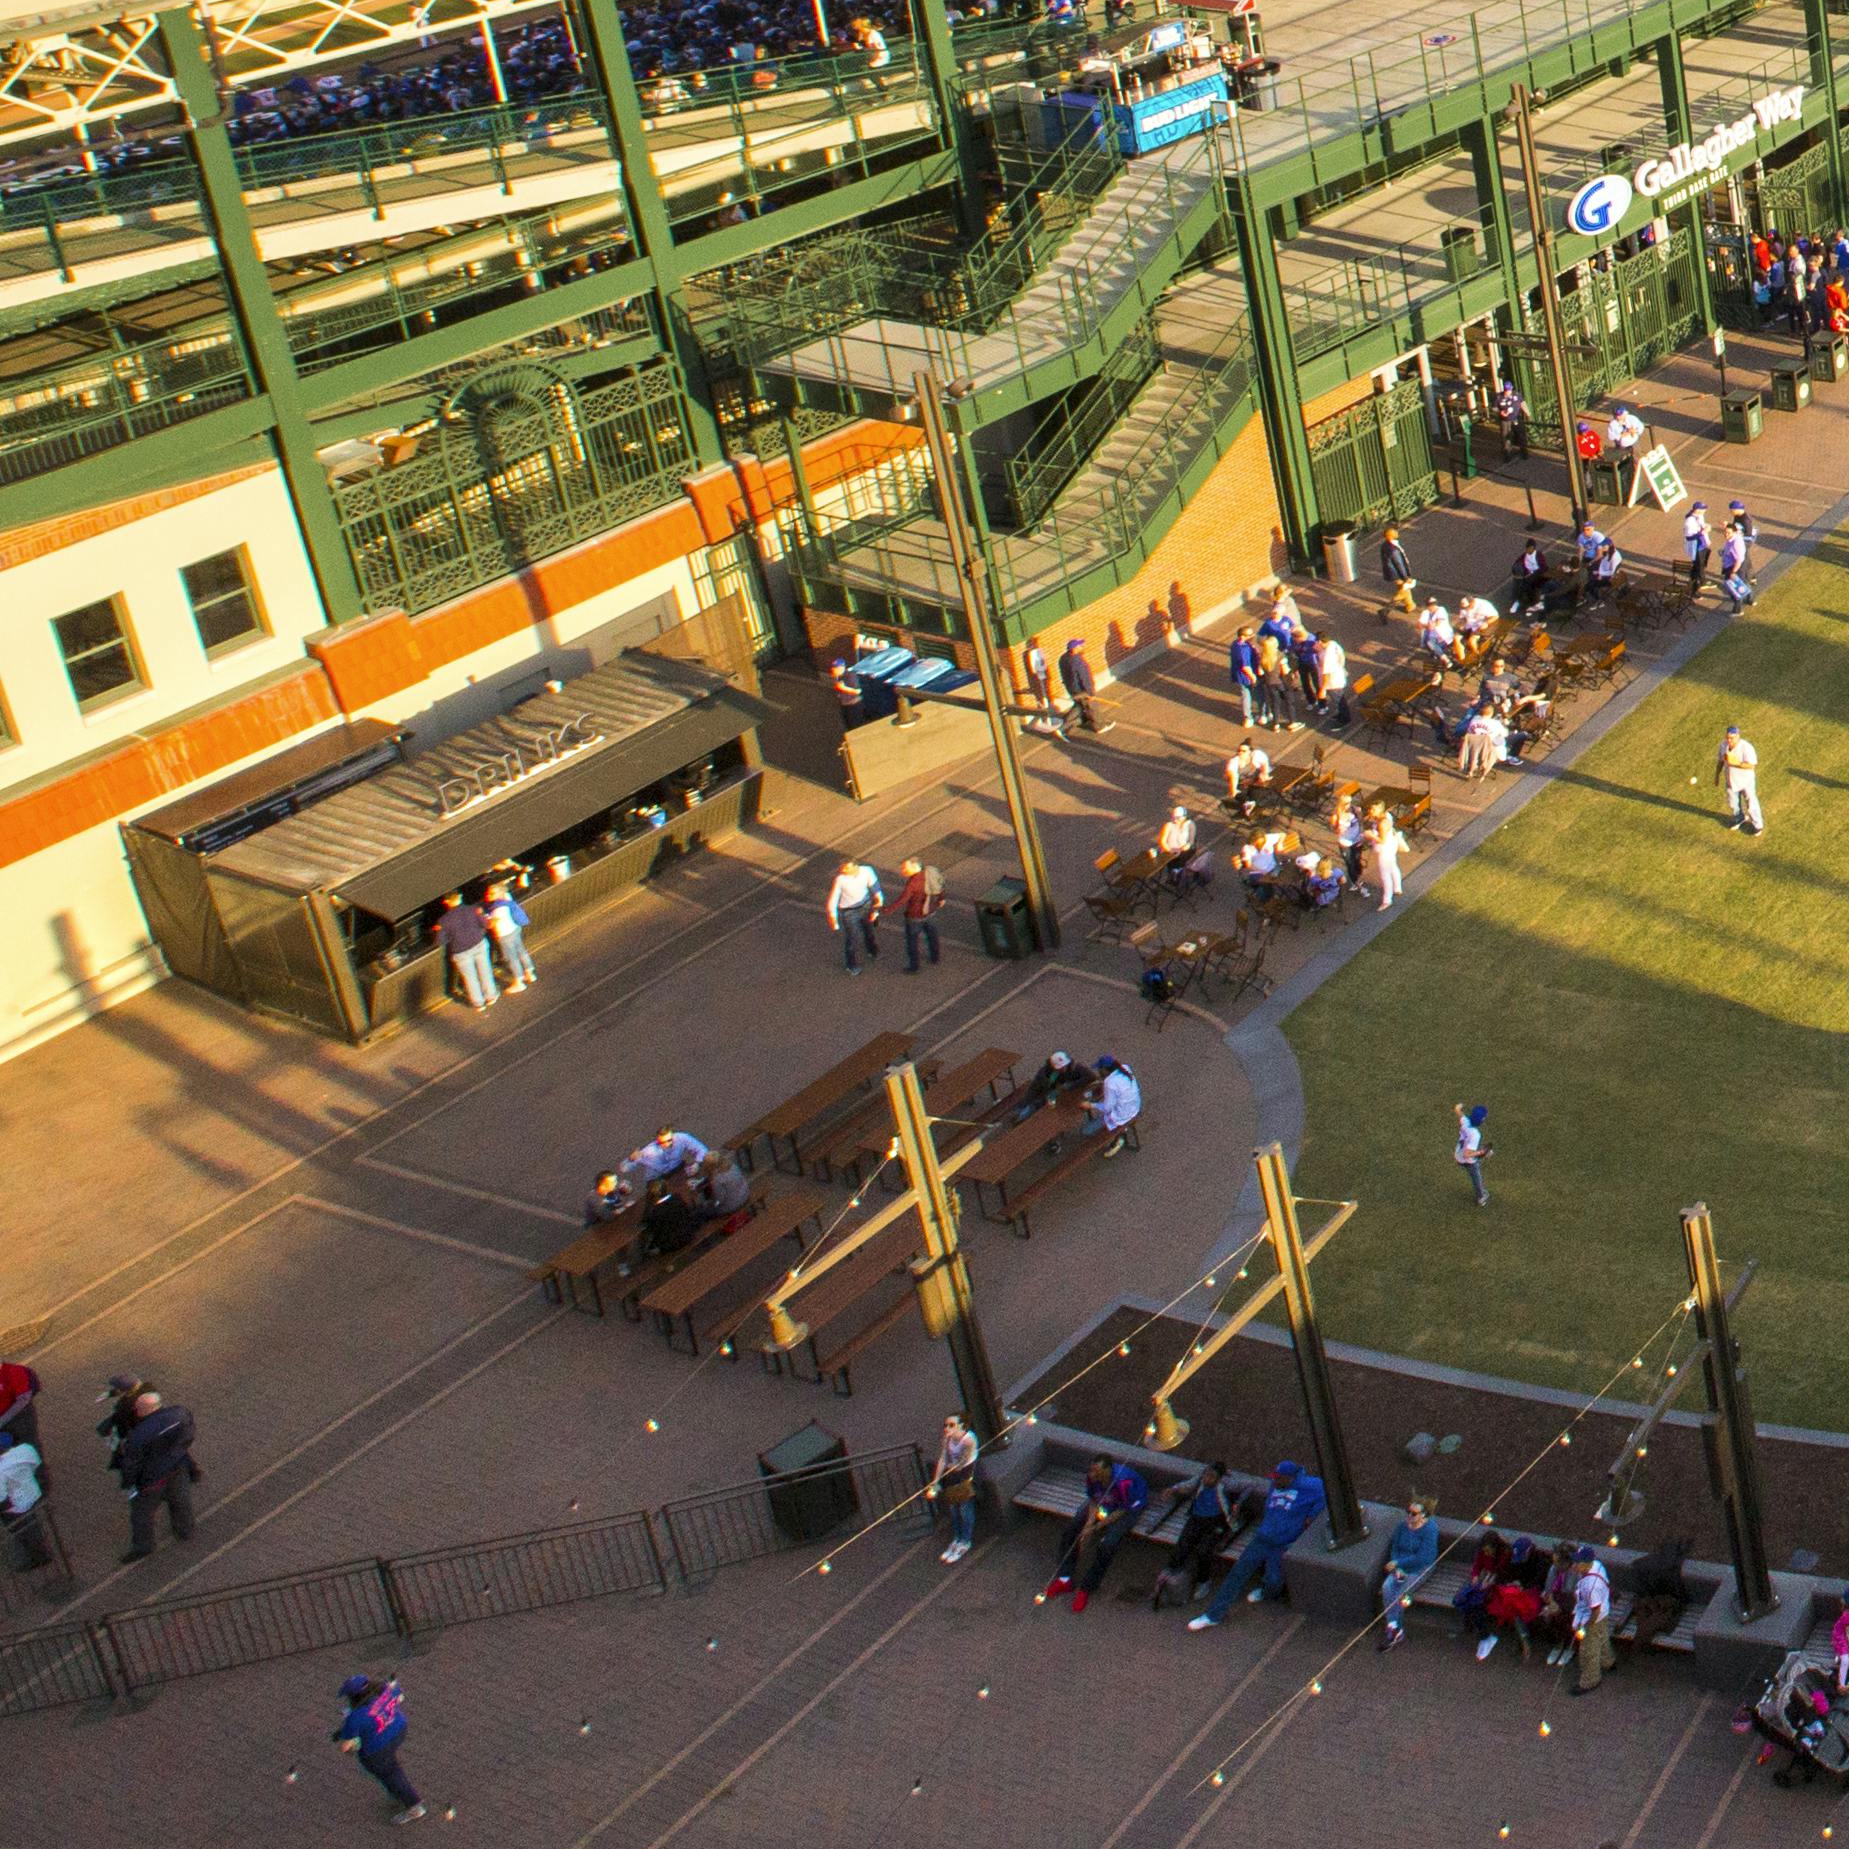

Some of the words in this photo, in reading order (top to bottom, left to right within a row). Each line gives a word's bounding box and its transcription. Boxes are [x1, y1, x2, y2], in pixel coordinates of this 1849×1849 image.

[1634, 113, 1757, 197] Gallagher
[1753, 86, 1804, 130] Way
[1663, 188, 1688, 210] THIRD
[1688, 177, 1708, 196] BASE
[1710, 165, 1729, 184] GATE
[437, 712, 597, 816] DRINKS
